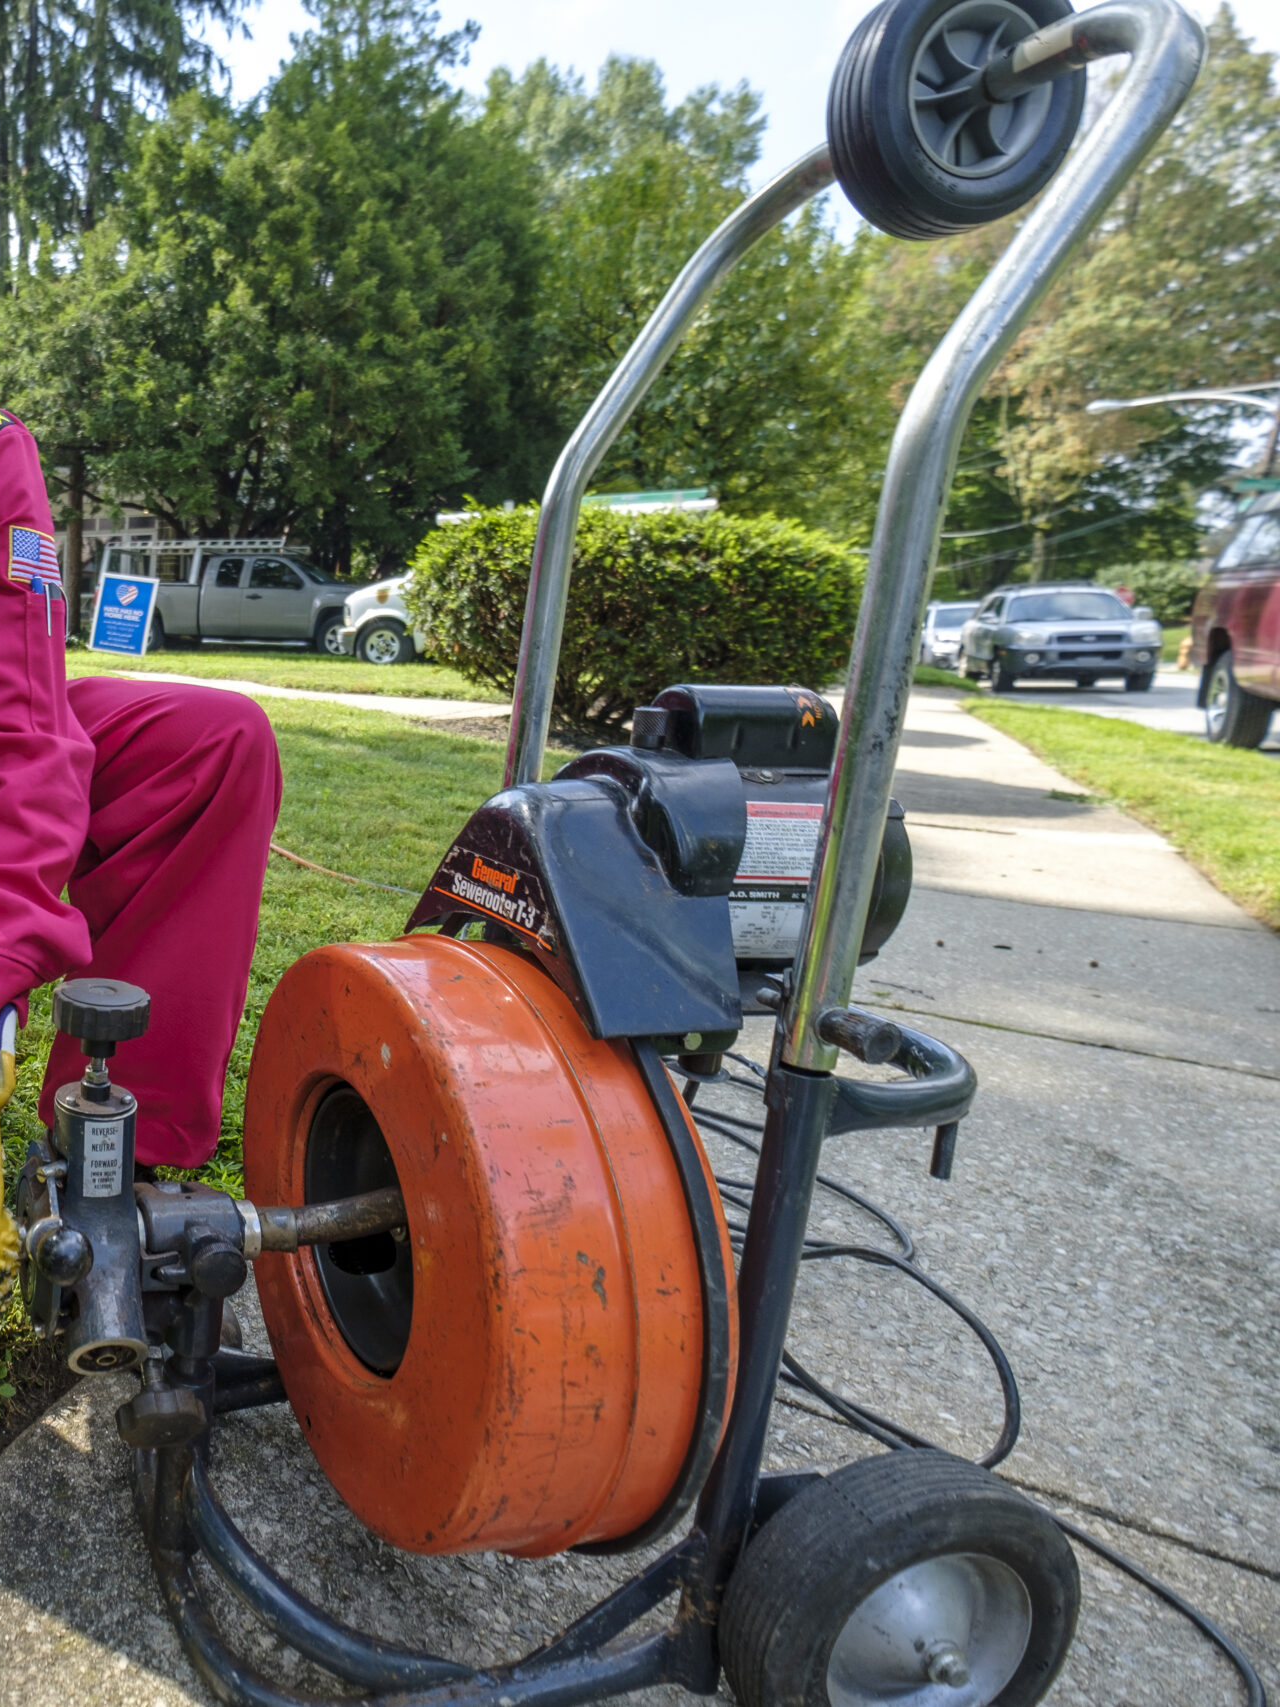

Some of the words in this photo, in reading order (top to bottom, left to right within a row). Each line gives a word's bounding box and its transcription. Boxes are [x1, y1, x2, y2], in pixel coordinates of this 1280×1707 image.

[472, 857, 517, 894] General
[748, 891, 780, 899] SMITH
[452, 872, 517, 919] Sewerooter
[516, 899, 536, 929] T-3
[91, 1143, 116, 1152] NEUTRAL
[90, 1159, 118, 1168] FORWARD
